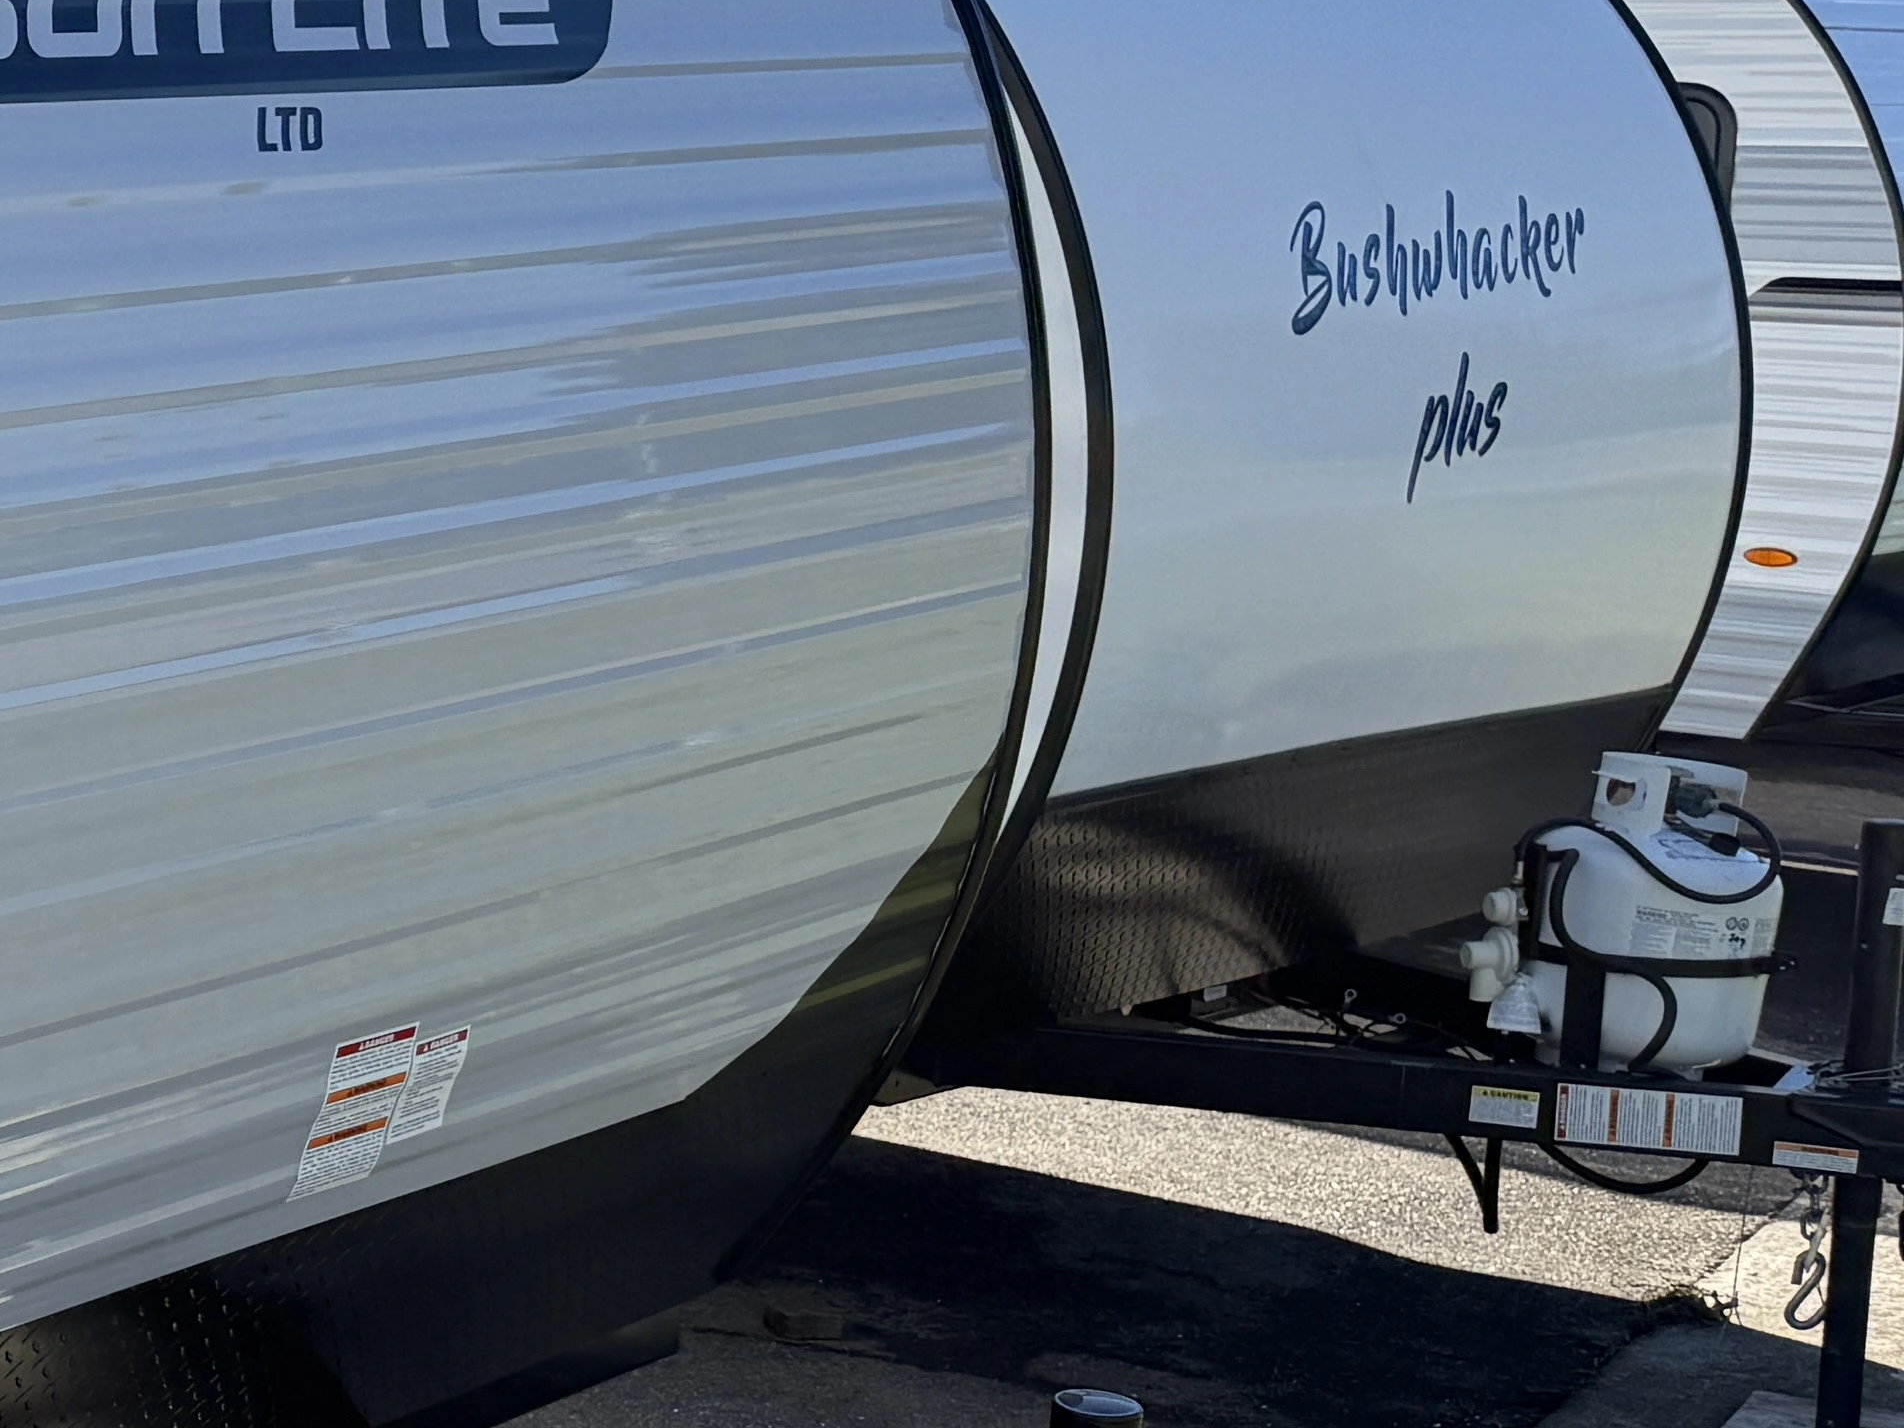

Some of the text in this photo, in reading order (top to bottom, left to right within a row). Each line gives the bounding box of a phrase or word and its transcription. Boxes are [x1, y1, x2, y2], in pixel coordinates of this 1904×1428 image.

[256, 106, 323, 153] LTD
[1290, 189, 1585, 336] Bushwhacker
[1406, 350, 1509, 504] plus
